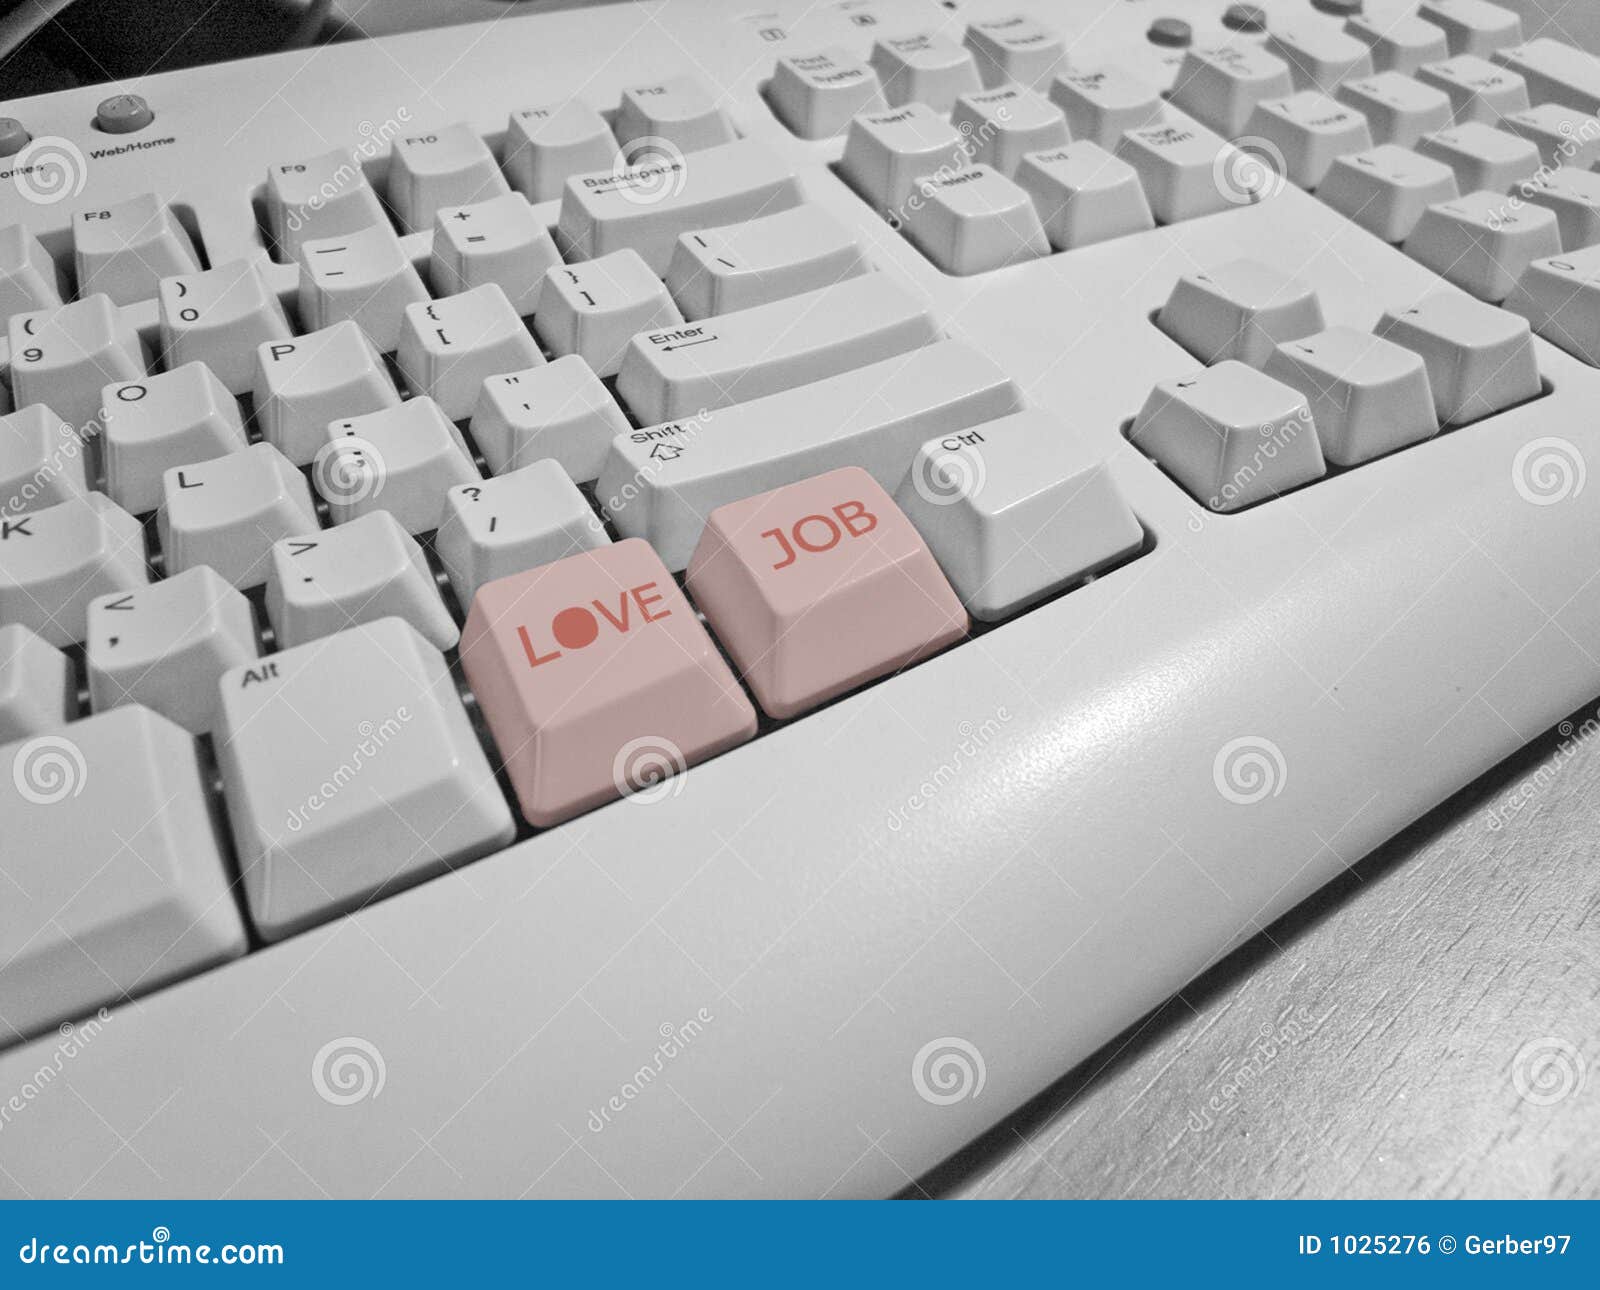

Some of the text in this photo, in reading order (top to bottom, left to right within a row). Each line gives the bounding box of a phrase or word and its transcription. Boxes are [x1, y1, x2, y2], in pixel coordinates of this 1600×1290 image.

[90, 137, 176, 160] Web/Home
[405, 134, 439, 146] F10
[280, 164, 307, 175] F9
[84, 210, 112, 222] F8
[648, 325, 705, 345] Enter
[23, 347, 44, 363] 9
[270, 343, 297, 362] P
[116, 385, 148, 402] O
[630, 424, 688, 444] Shift
[941, 430, 986, 452] Ctrl
[177, 471, 205, 490] L
[461, 486, 482, 502] ?
[1, 517, 33, 541] K
[761, 499, 879, 571] JOB
[516, 581, 673, 668] LOVE
[241, 662, 280, 689] Alt
